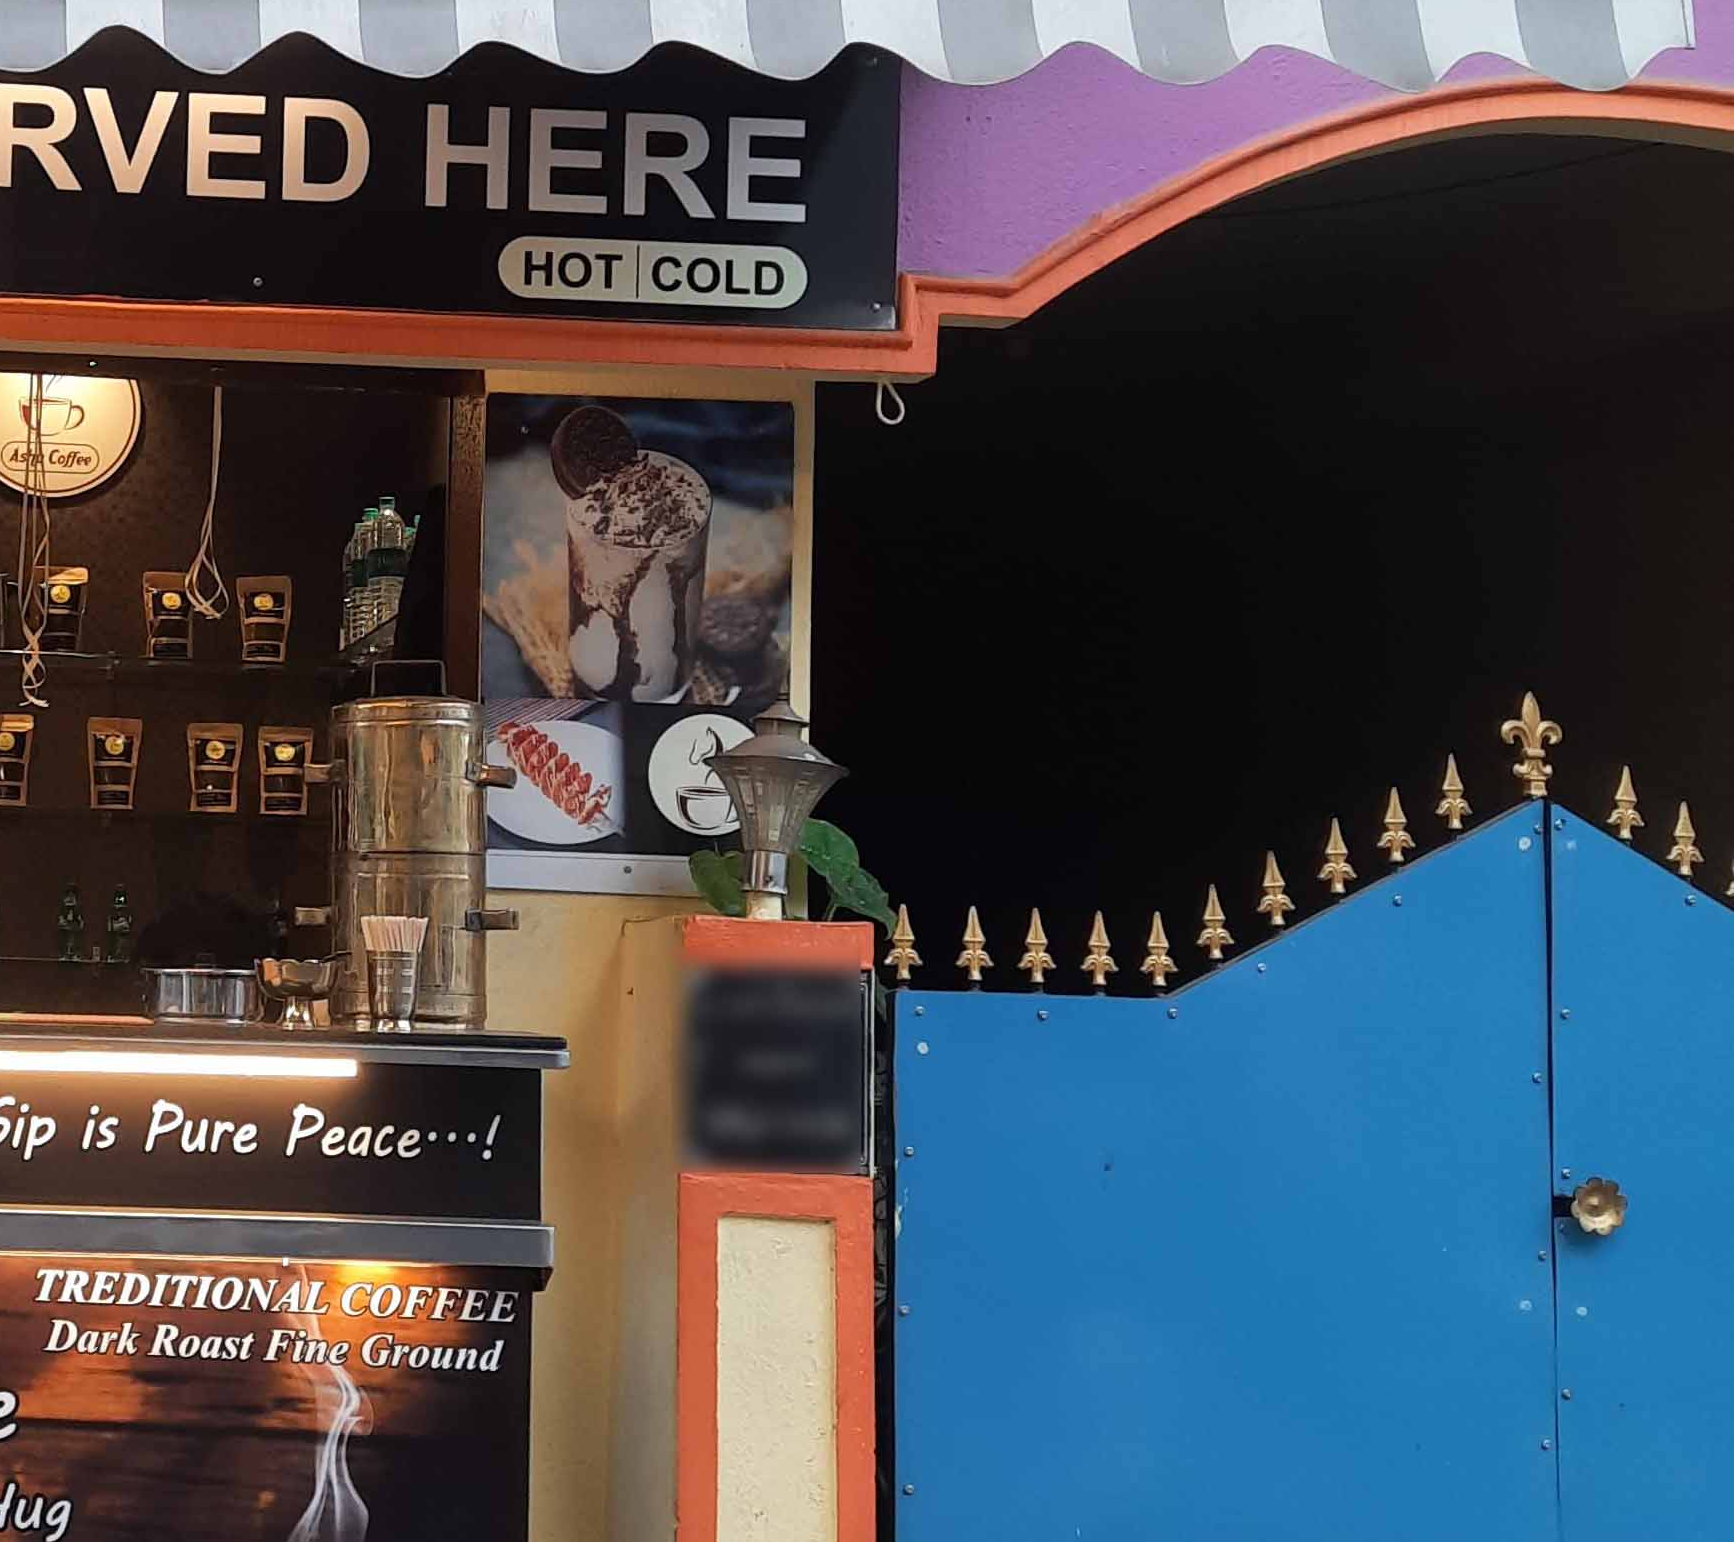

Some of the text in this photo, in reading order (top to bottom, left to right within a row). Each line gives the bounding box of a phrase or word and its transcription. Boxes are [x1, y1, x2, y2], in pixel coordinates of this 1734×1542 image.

[423, 103, 808, 225] HERE
[521, 248, 786, 298] HOT COLD
[49, 448, 92, 468] Coffee
[82, 1104, 117, 1152] is
[144, 1099, 258, 1157] Pure
[34, 1267, 520, 1325] TREDITIONAL COFFEE
[43, 1319, 506, 1373] Dark Roast Fine Ground
